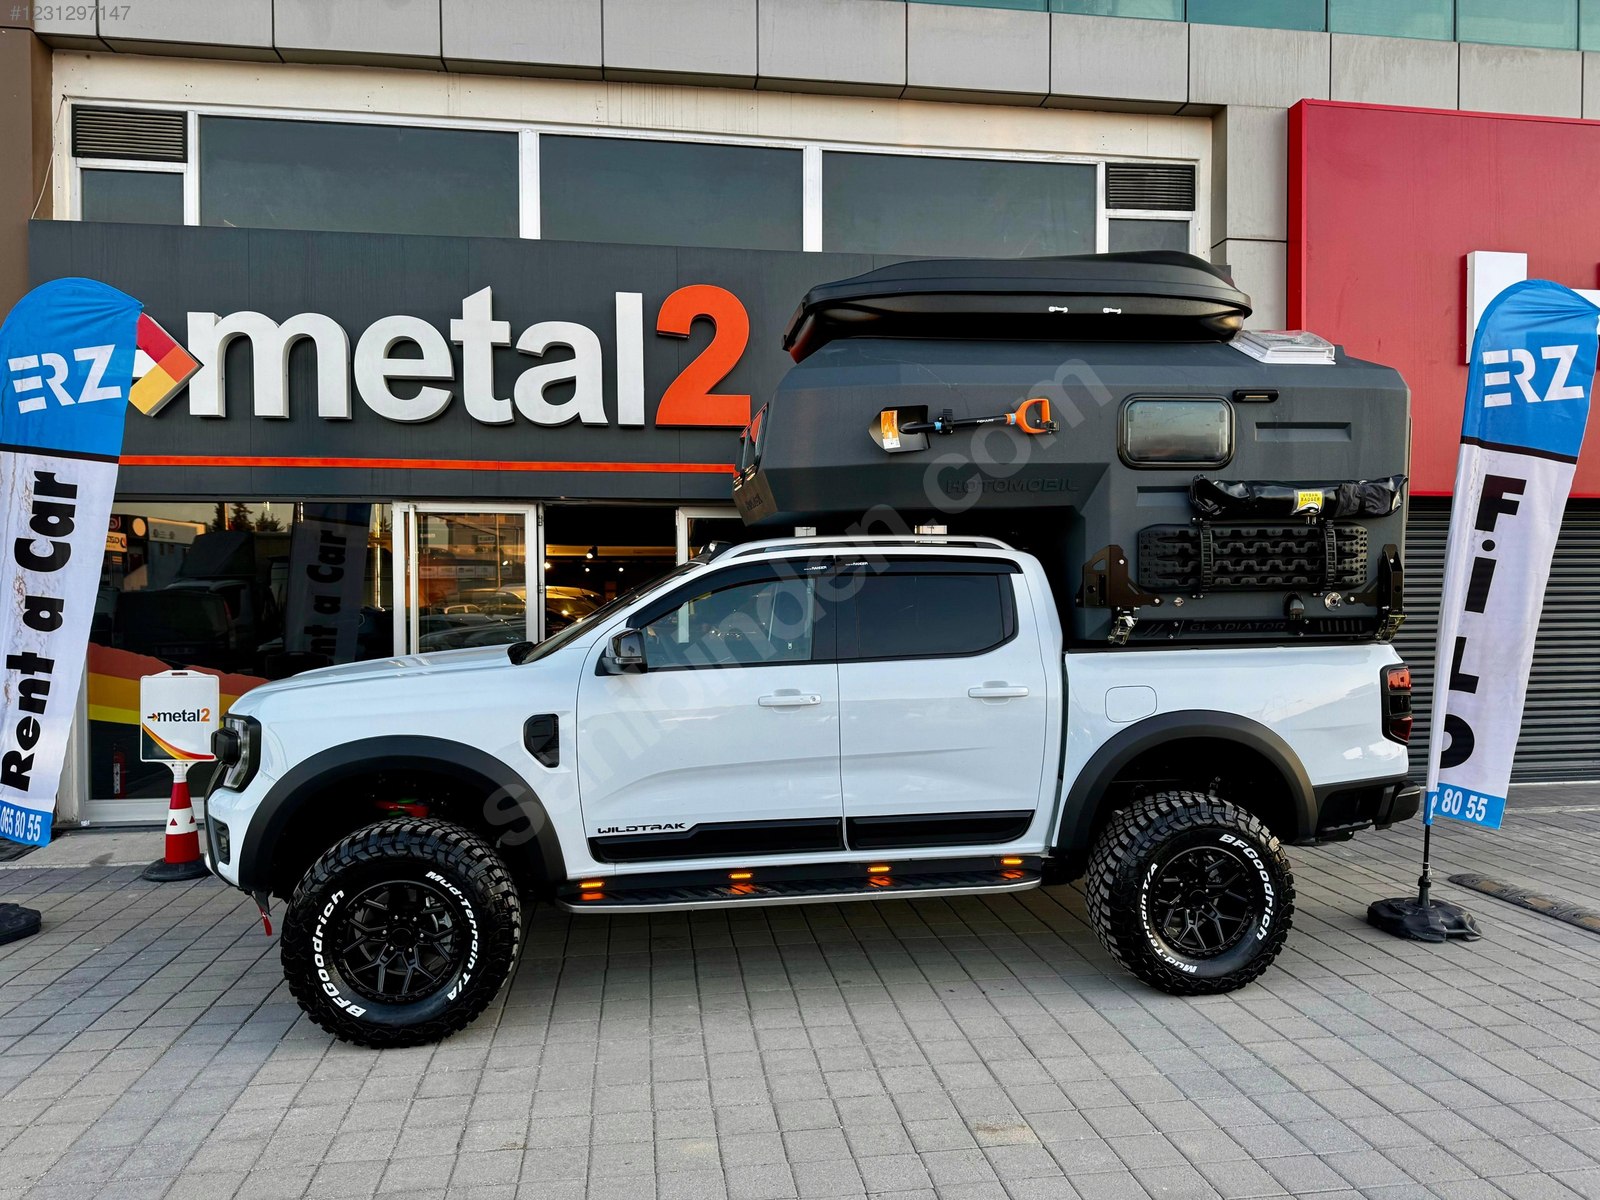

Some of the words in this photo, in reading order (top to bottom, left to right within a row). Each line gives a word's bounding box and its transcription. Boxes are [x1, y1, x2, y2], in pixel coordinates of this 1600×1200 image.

[8, 344, 122, 414] ERZ
[187, 284, 751, 429] metal2
[1482, 345, 1585, 408] ERZ
[14, 471, 78, 572] Car
[22, 595, 65, 632] a
[1190, 622, 1286, 632] GLADIATOR
[1, 652, 55, 792] Rent
[157, 708, 211, 723] metal2
[14, 811, 26, 839] 80
[26, 813, 42, 842] 55
[597, 822, 686, 834] WILDTRAK
[1441, 788, 1463, 815] 80
[1465, 794, 1489, 821] 55
[1142, 863, 1158, 890] T/A
[1219, 833, 1275, 941] BFGoodrich
[425, 871, 479, 970] Mud-Terrain
[1140, 894, 1198, 974] Mud-Terrain
[312, 889, 367, 1018] BFGoodrich
[447, 972, 471, 1001] T/A
